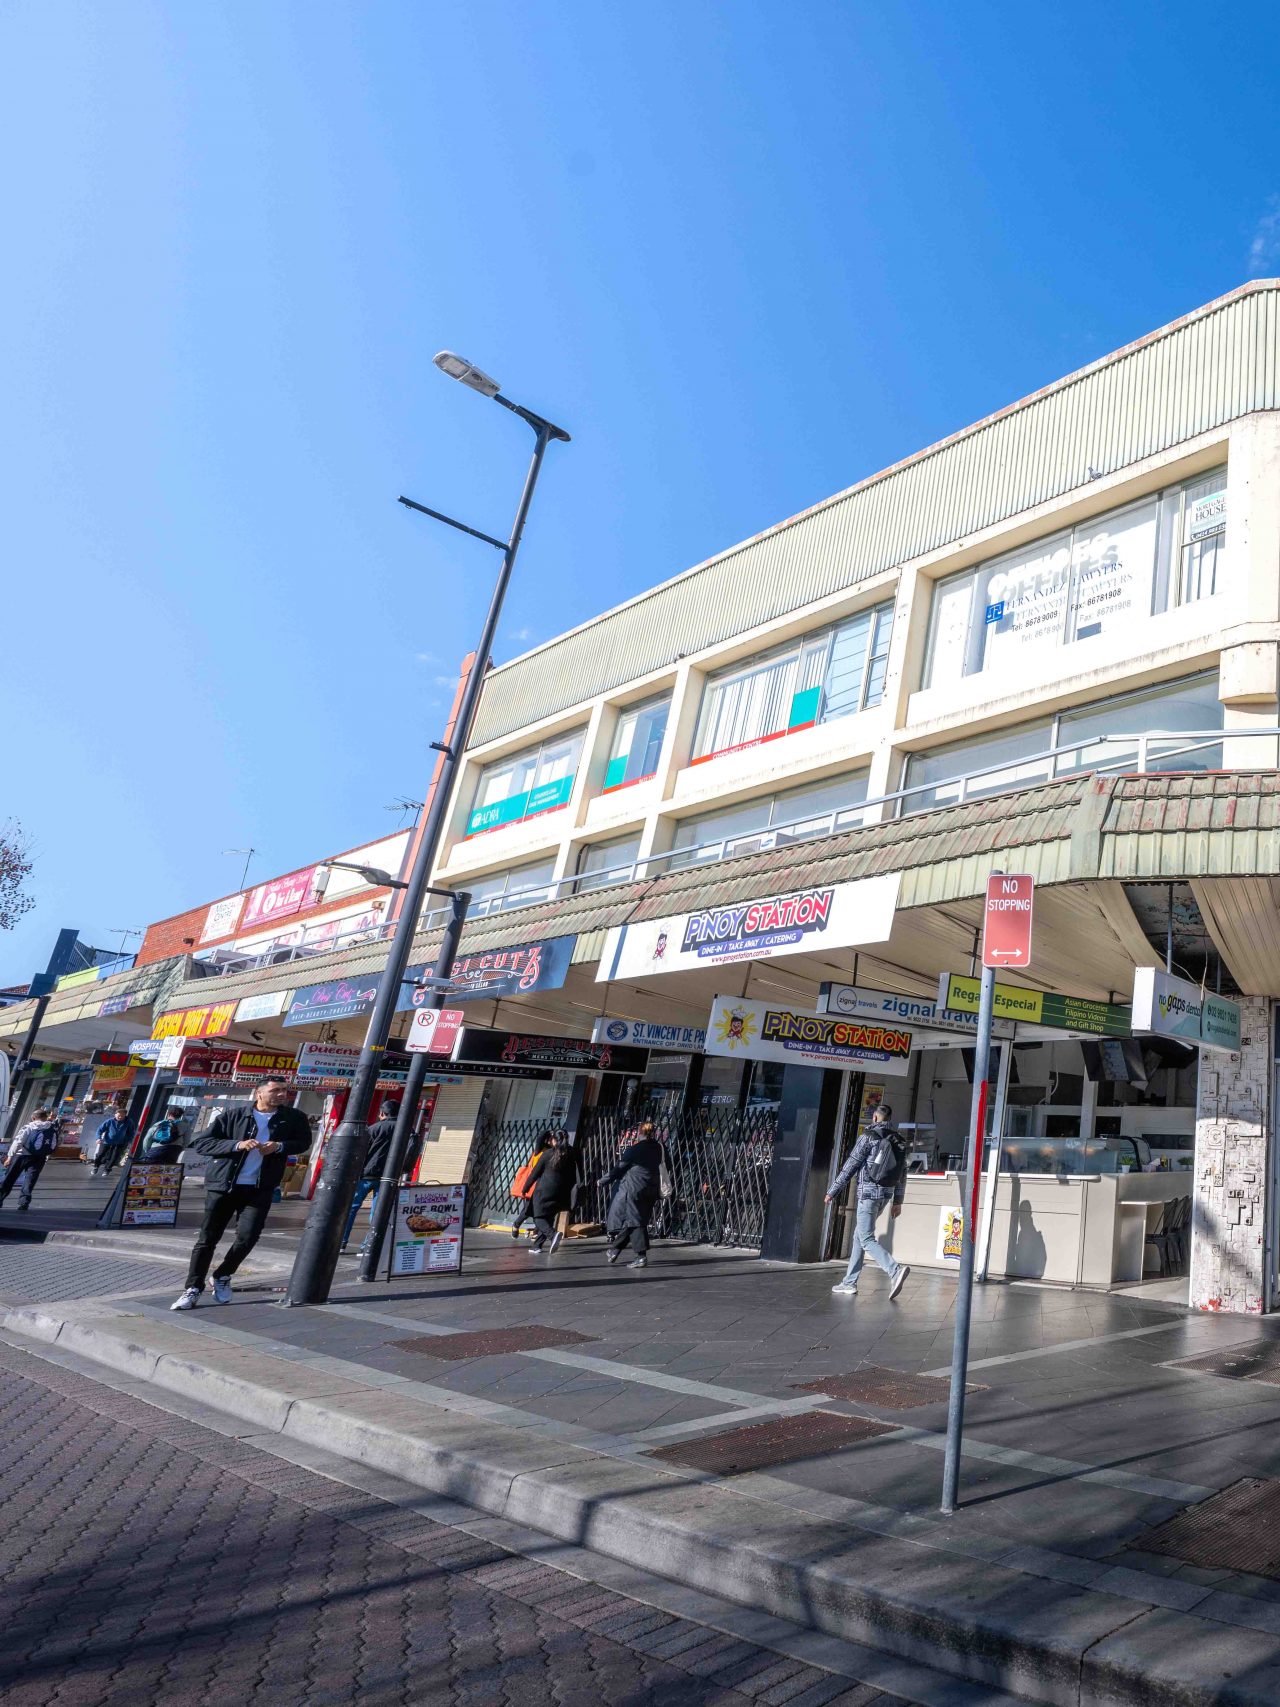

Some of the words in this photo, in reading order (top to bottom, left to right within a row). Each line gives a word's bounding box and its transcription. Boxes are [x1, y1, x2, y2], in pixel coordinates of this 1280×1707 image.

[1196, 504, 1226, 521] HOUSE
[1006, 579, 1066, 612] FERNANDEZ
[1072, 561, 1124, 587] LAWYERS
[1070, 600, 1086, 612] Fax:
[1011, 622, 1024, 633] Tel:
[713, 746, 743, 760] COMMUNITY
[1002, 880, 1018, 894] NO
[988, 899, 1031, 911] STOPPING
[701, 943, 723, 956] DINE-IN
[765, 932, 797, 945] CATERING
[479, 946, 542, 989] CUTZ
[952, 987, 981, 1006] Rega
[994, 995, 1037, 1011] Especial
[1065, 998, 1082, 1008] Asian
[1083, 1002, 1108, 1013] Groceries
[1167, 995, 1186, 1015] gaps
[882, 996, 936, 1018] zignal
[153, 1013, 183, 1040] DESIGN
[181, 1007, 209, 1035] PRINT
[206, 1002, 236, 1034] COPY
[446, 1013, 455, 1021] NO
[1065, 1009, 1087, 1021] Filipino
[1088, 1012, 1106, 1022] Videos
[633, 1022, 645, 1038] ST.
[647, 1024, 681, 1041] VINCENT
[682, 1028, 693, 1042] DE
[694, 1029, 707, 1043] PA
[1066, 1020, 1077, 1028] and
[1078, 1021, 1089, 1030] Gift
[1089, 1023, 1104, 1032] Shop
[131, 1041, 163, 1052] HOSPITAL
[1241, 1037, 1252, 1045] 24
[788, 1042, 812, 1051] DINE-IN
[819, 1046, 834, 1054] TAKE
[857, 1051, 885, 1060] CATERING
[240, 1053, 273, 1068] MAIN
[402, 1206, 427, 1215] RICE
[431, 1204, 458, 1214] BOWL
